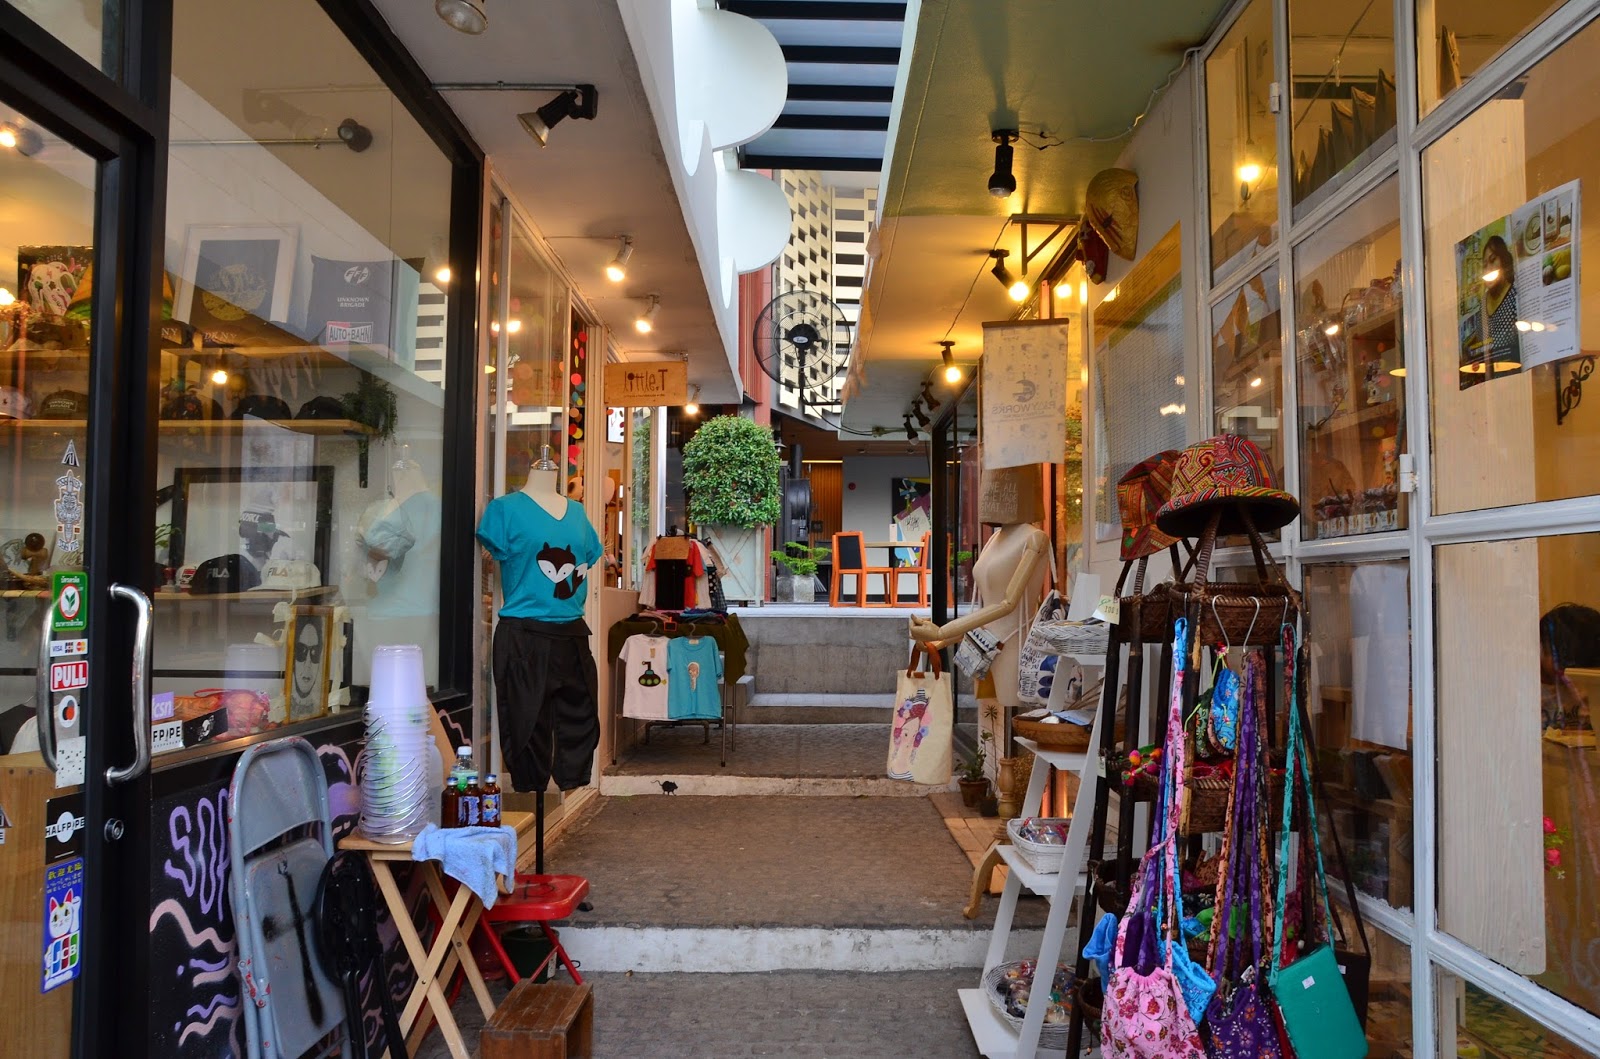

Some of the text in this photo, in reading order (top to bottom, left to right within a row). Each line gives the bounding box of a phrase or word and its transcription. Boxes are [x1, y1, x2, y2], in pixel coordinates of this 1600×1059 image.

[161, 327, 178, 336] NY
[206, 568, 230, 578] FILA
[267, 567, 288, 577] FILA
[55, 665, 86, 688] PULL
[45, 819, 85, 836] HALFPIPE
[46, 878, 82, 894] WELCOME
[51, 944, 77, 963] JCB
